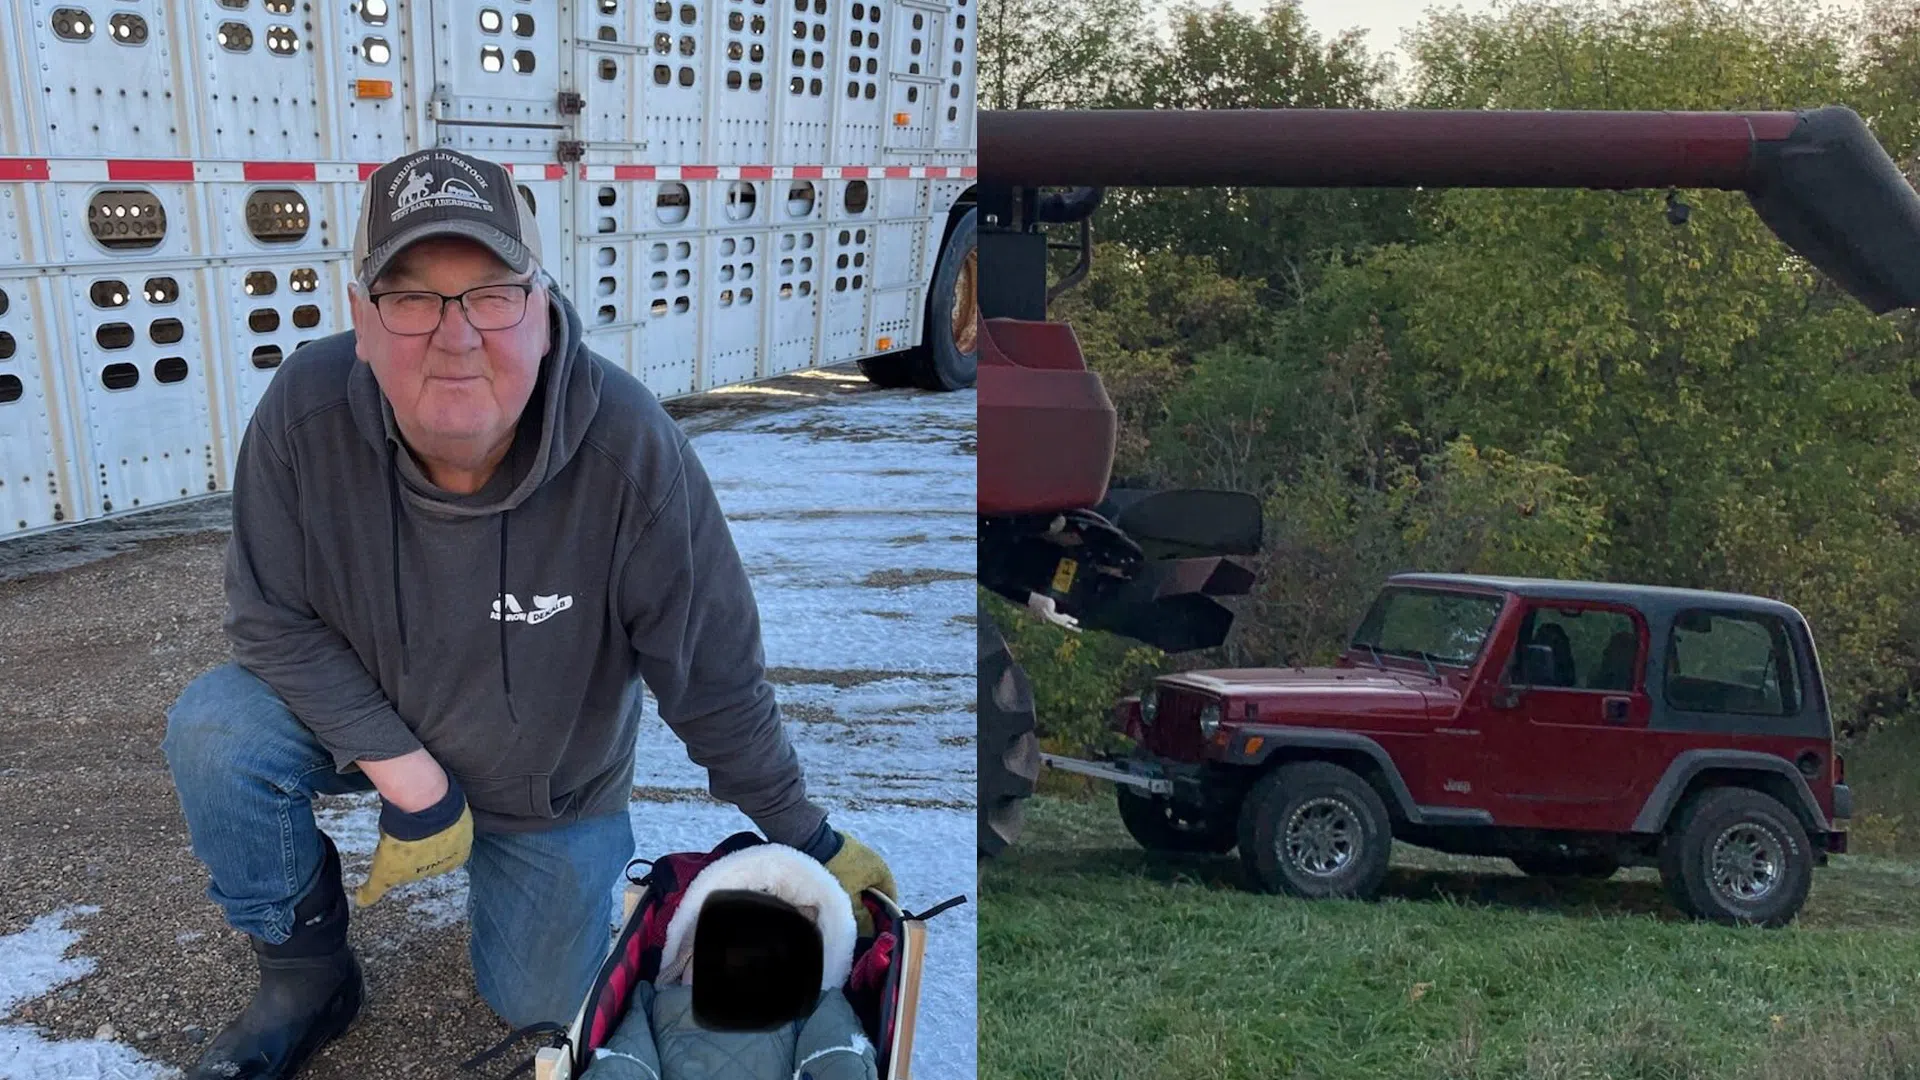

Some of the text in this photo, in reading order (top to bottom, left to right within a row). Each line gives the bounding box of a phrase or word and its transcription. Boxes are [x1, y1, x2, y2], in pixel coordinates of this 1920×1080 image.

[388, 153, 489, 198] ABERDEEN LIVESTOCK
[391, 208, 410, 222] WEST
[1443, 778, 1471, 794] Jeep
